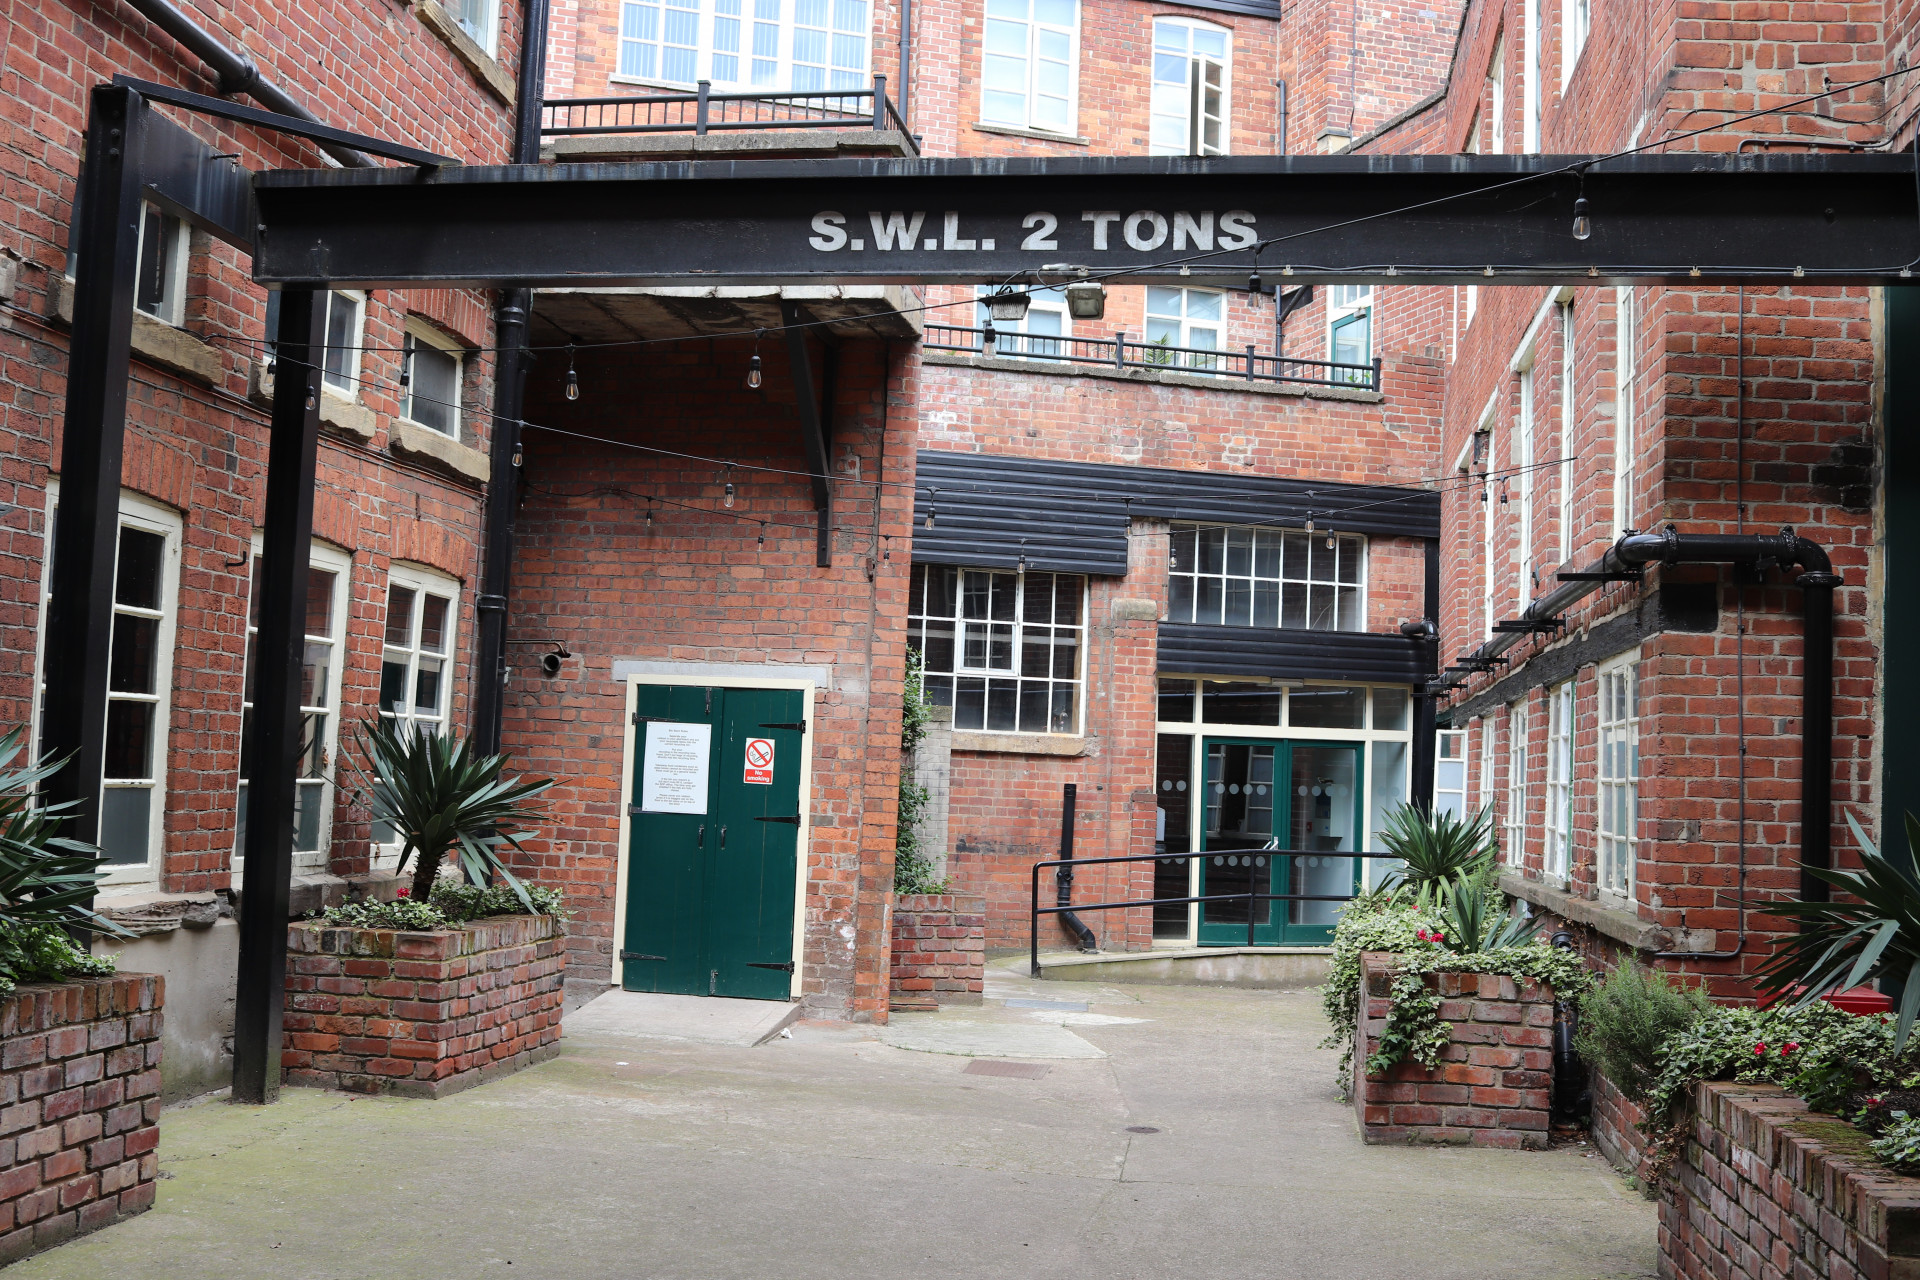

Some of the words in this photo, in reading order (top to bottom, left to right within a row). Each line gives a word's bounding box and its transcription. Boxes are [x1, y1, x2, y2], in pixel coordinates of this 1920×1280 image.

[808, 210, 996, 252] S.W.L.
[1020, 211, 1058, 251] 2
[1081, 209, 1258, 252] TONS
